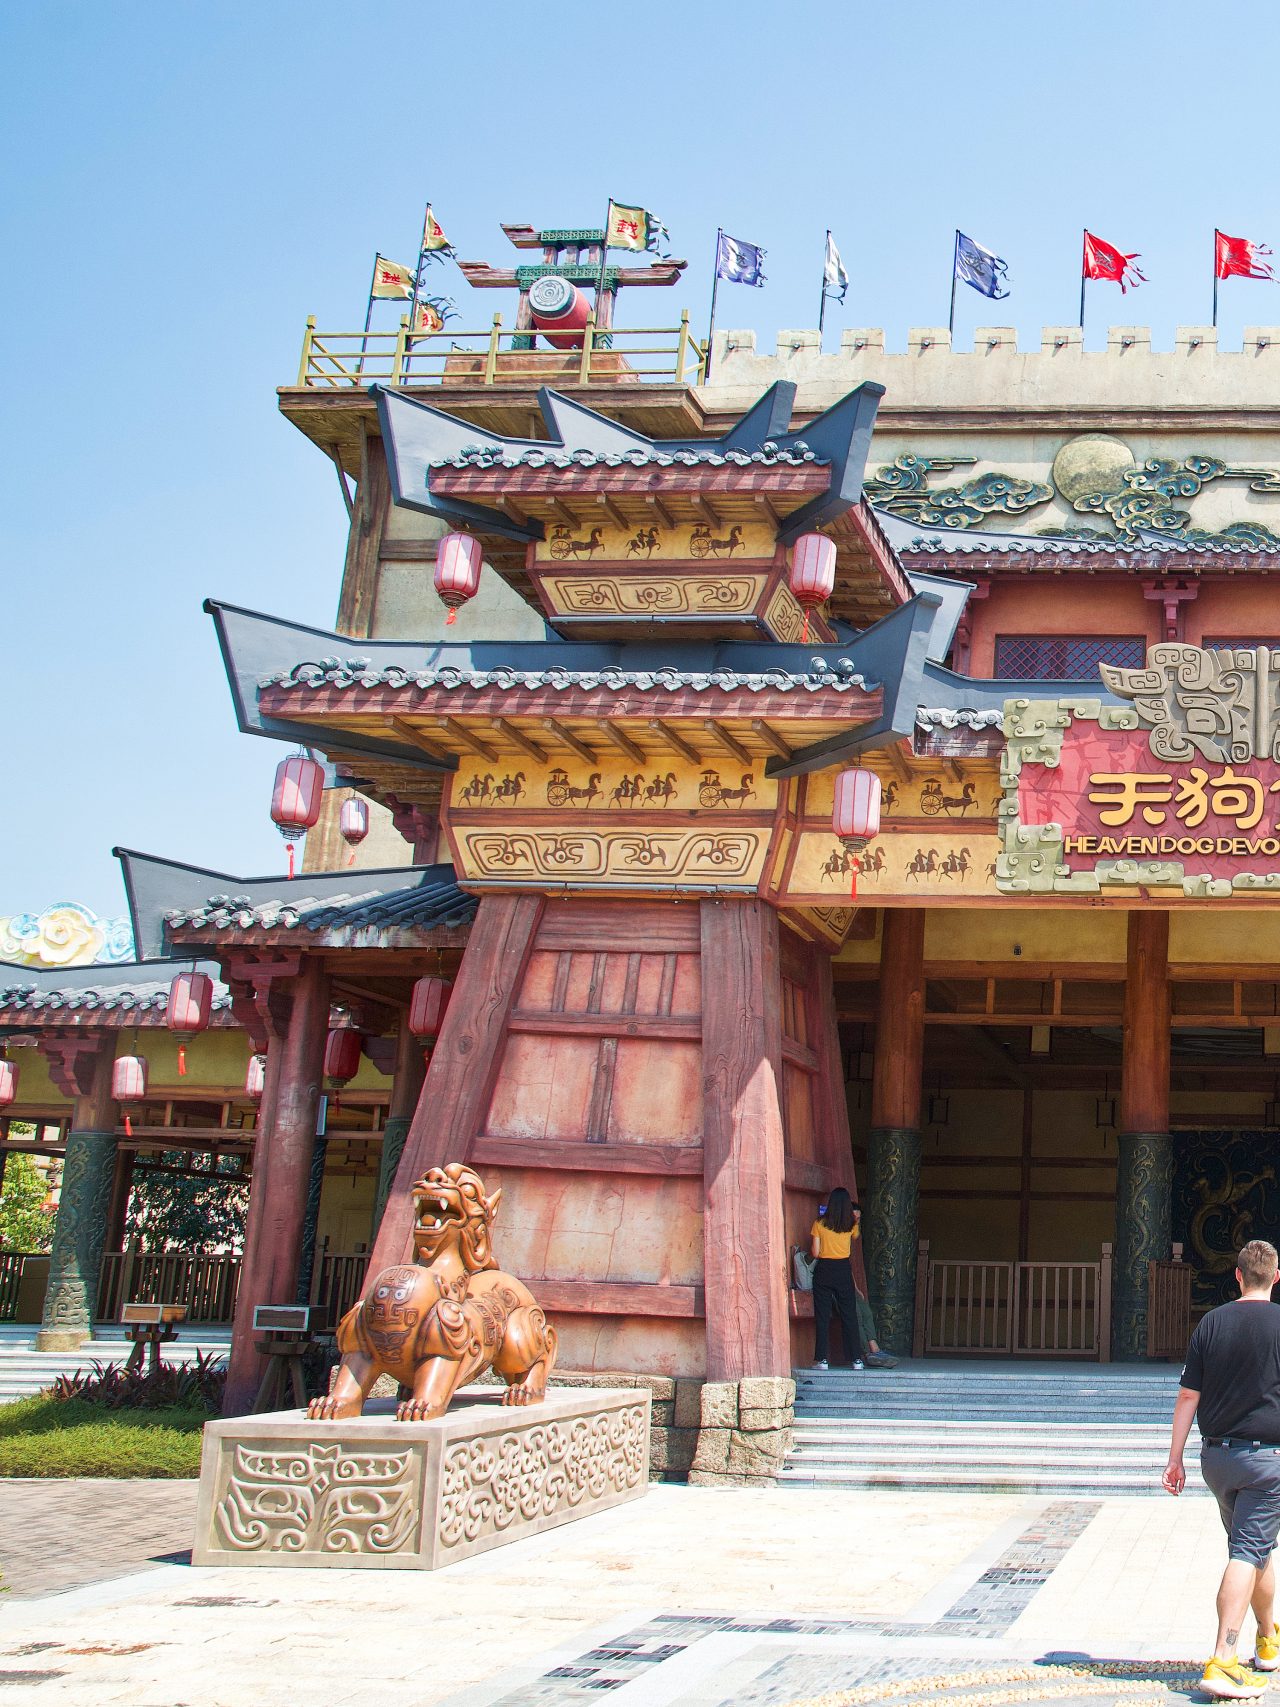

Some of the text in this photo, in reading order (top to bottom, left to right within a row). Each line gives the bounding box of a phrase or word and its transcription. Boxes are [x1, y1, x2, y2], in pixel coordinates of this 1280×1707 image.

[617, 219, 639, 240] 越
[1065, 836, 1159, 854] HEAVEN
[1160, 837, 1215, 855] DOG
